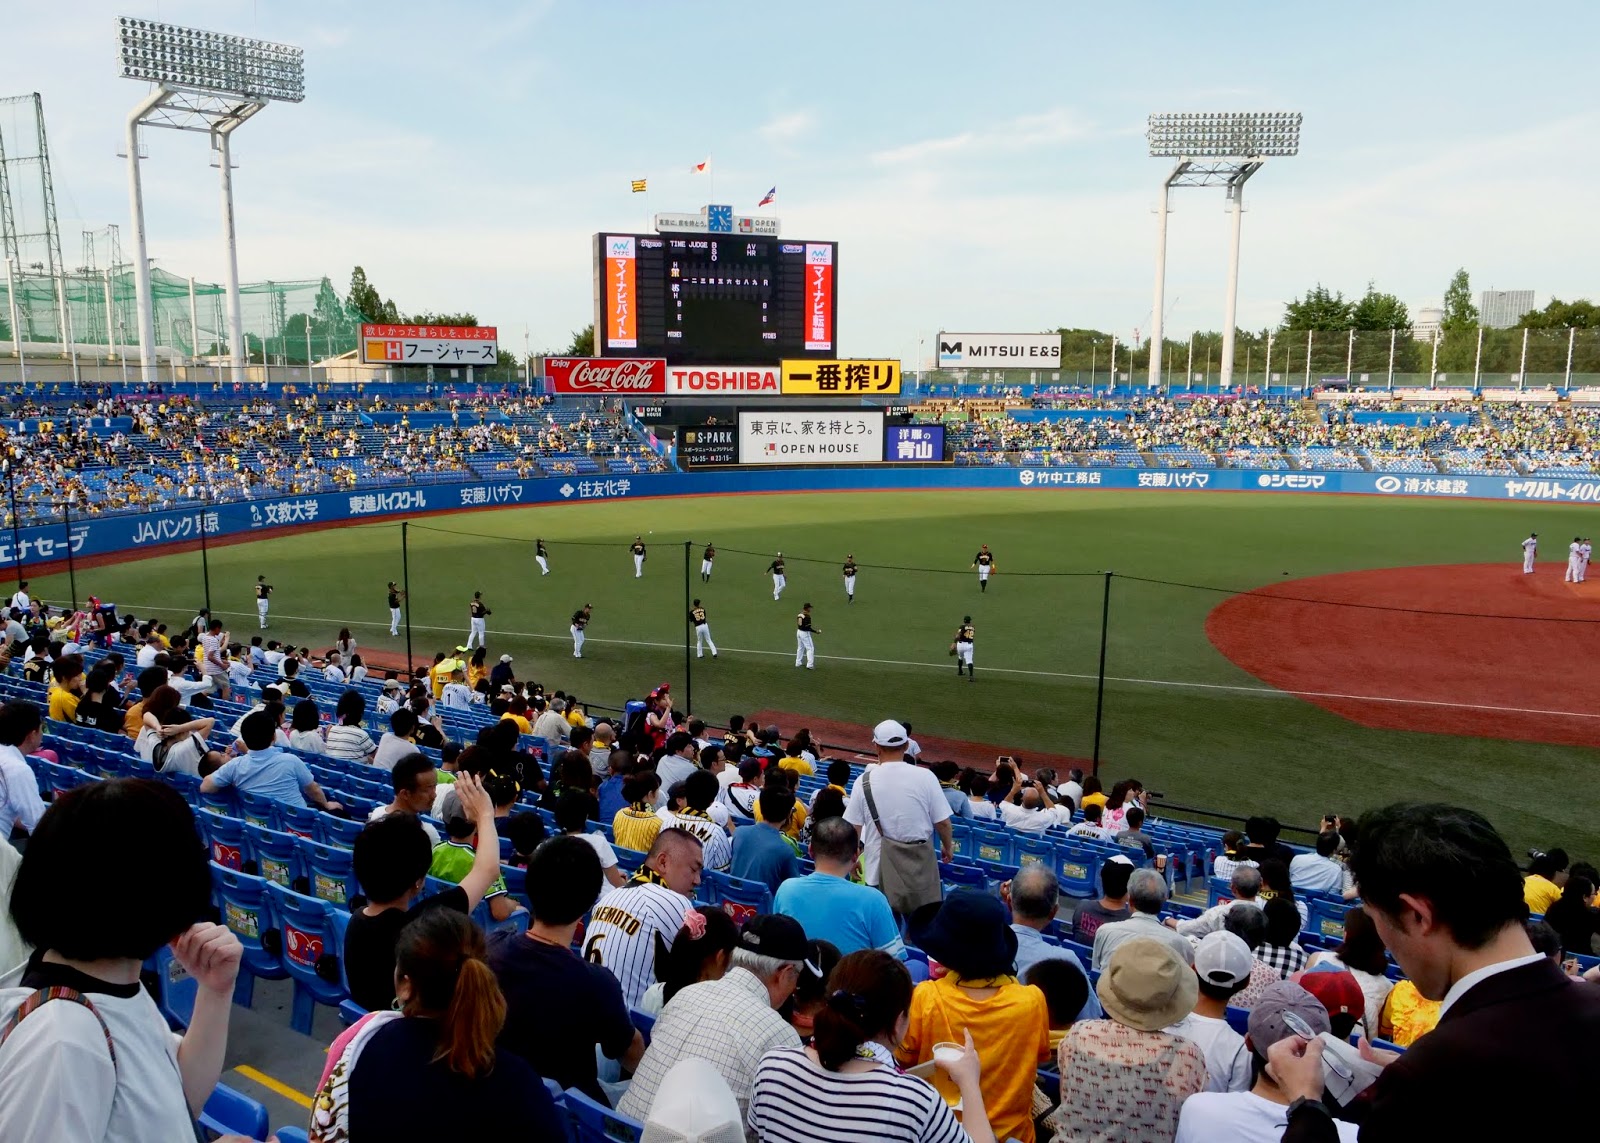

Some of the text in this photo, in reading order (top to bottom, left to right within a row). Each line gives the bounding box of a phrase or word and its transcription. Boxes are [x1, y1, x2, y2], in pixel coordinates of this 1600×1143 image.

[688, 241, 709, 249] JUDGE
[615, 259, 628, 338] マイナビバイト
[811, 265, 825, 341] マイナビ転職
[405, 342, 495, 361] フージャース
[969, 345, 1060, 358] MITSUI E&S
[551, 359, 571, 369] Enjoy
[568, 360, 657, 389] Coca-Cola
[672, 370, 778, 391] TOSHIBA
[788, 363, 893, 392] 一番搾り
[750, 419, 874, 436] 東京に、家を持とう。
[898, 428, 931, 440] 洋服の
[780, 443, 860, 454] OPEN HOUSE
[896, 440, 933, 459] 青山
[1036, 471, 1102, 485] 竹中工務店
[1138, 471, 1209, 488] 安藤ハザマ
[1270, 473, 1326, 489] シモジマ
[1403, 477, 1469, 495] 清水建設
[460, 484, 524, 506] 安藤ハザマ
[577, 479, 632, 498] 住友化学
[349, 489, 427, 515] 東進ハイスクール
[264, 499, 319, 526] 文教大学
